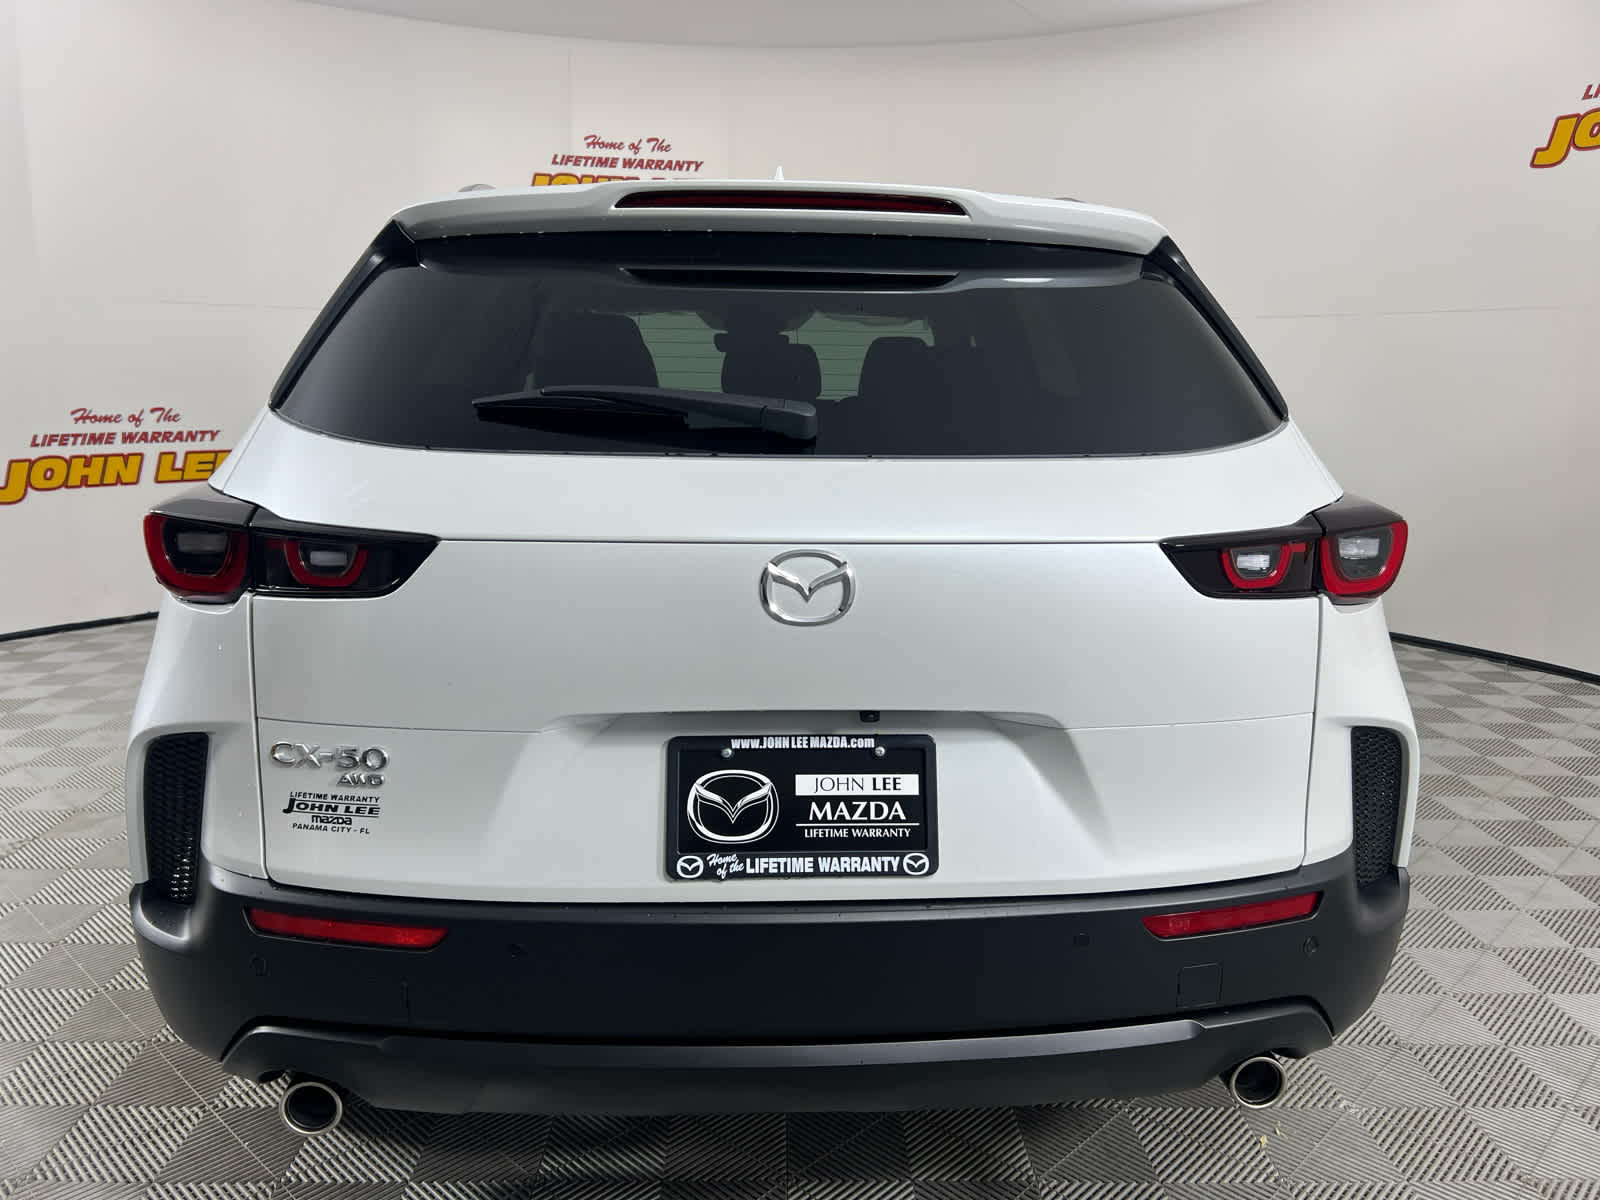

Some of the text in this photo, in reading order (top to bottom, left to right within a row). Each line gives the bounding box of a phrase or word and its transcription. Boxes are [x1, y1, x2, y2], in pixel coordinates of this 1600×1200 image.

[584, 134, 672, 154] Home of The
[552, 154, 704, 172] LIFETIME WARRANTY
[70, 407, 181, 427] Home of The
[30, 430, 221, 447] LIFETIME WARRANTY
[0, 453, 144, 505] JOHN
[270, 740, 390, 770] CX-50
[814, 776, 902, 793] JOHN LEE
[283, 798, 380, 815] JOHN LEE
[290, 792, 380, 803] LIFETIME WARRANTY
[809, 801, 906, 821] MAZDA
[292, 823, 328, 832] PANAMA
[804, 828, 911, 838] LIFETIME WARRANTY
[707, 853, 738, 867] Home
[746, 856, 900, 874] LIFETIME WARRANTY
[717, 860, 745, 879] of the
